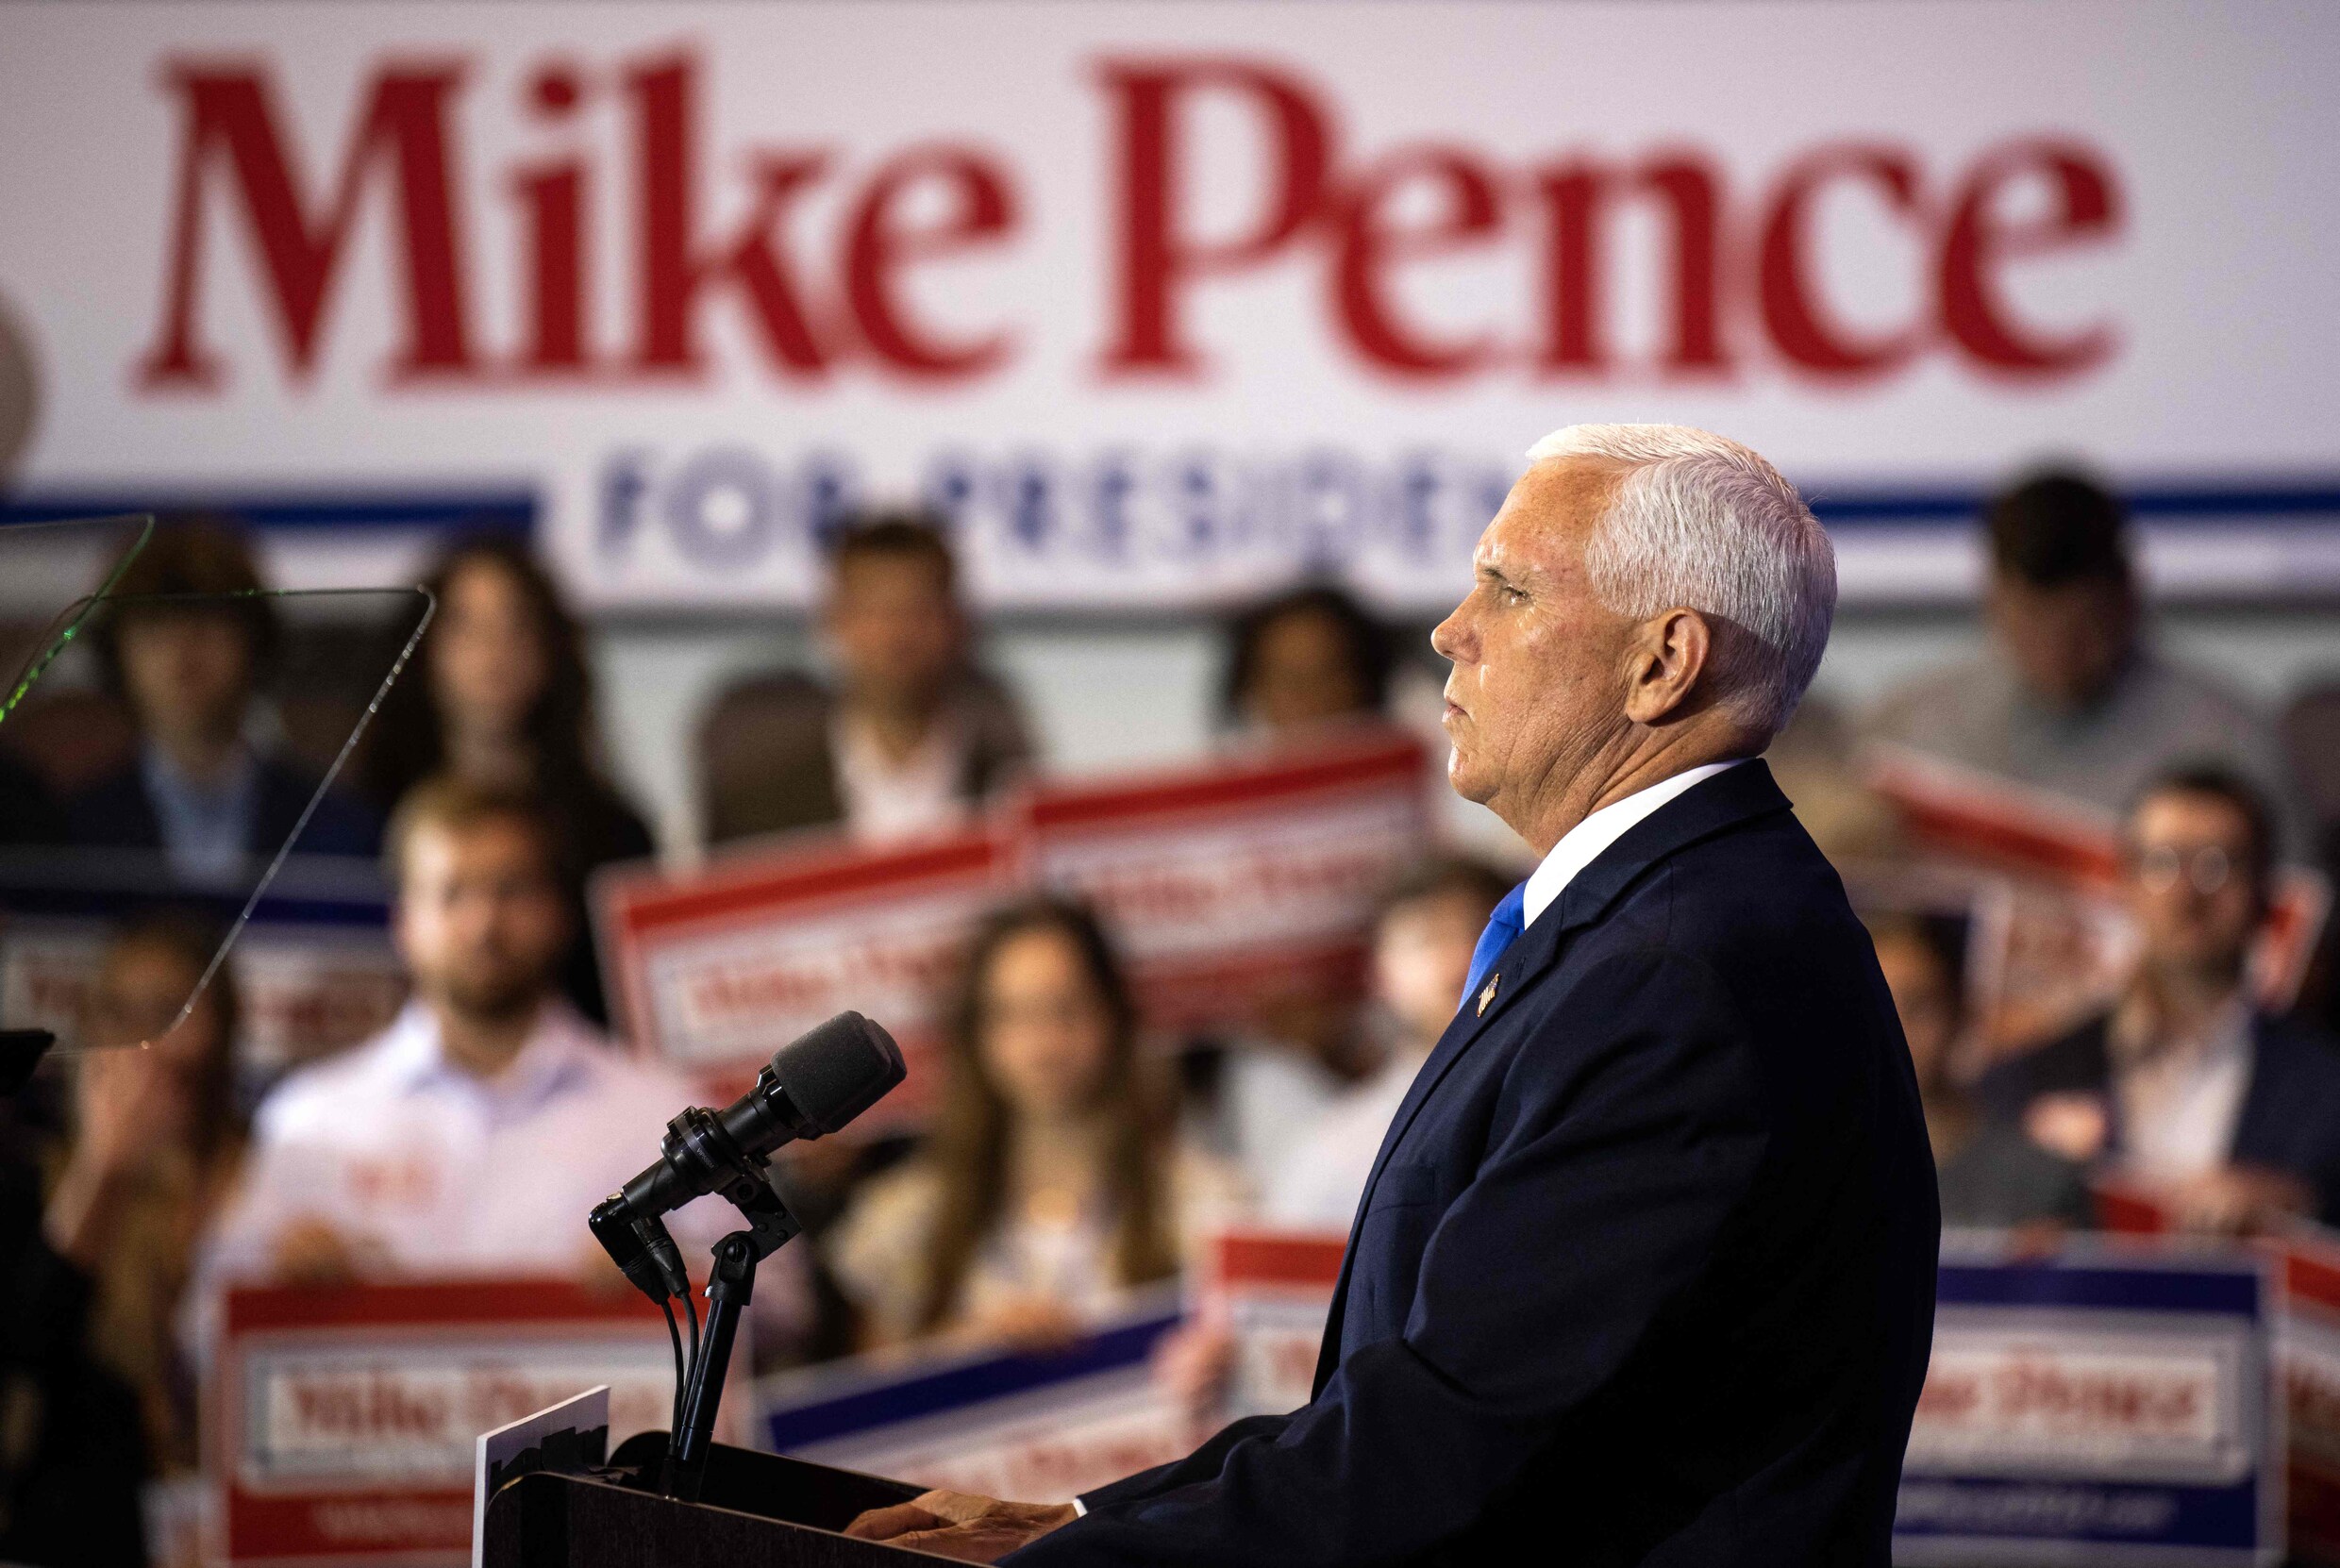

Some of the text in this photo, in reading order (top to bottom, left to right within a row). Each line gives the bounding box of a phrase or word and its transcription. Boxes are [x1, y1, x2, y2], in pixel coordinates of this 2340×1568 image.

[139, 43, 2125, 392] Mike Pence
[596, 449, 862, 568] FOR
